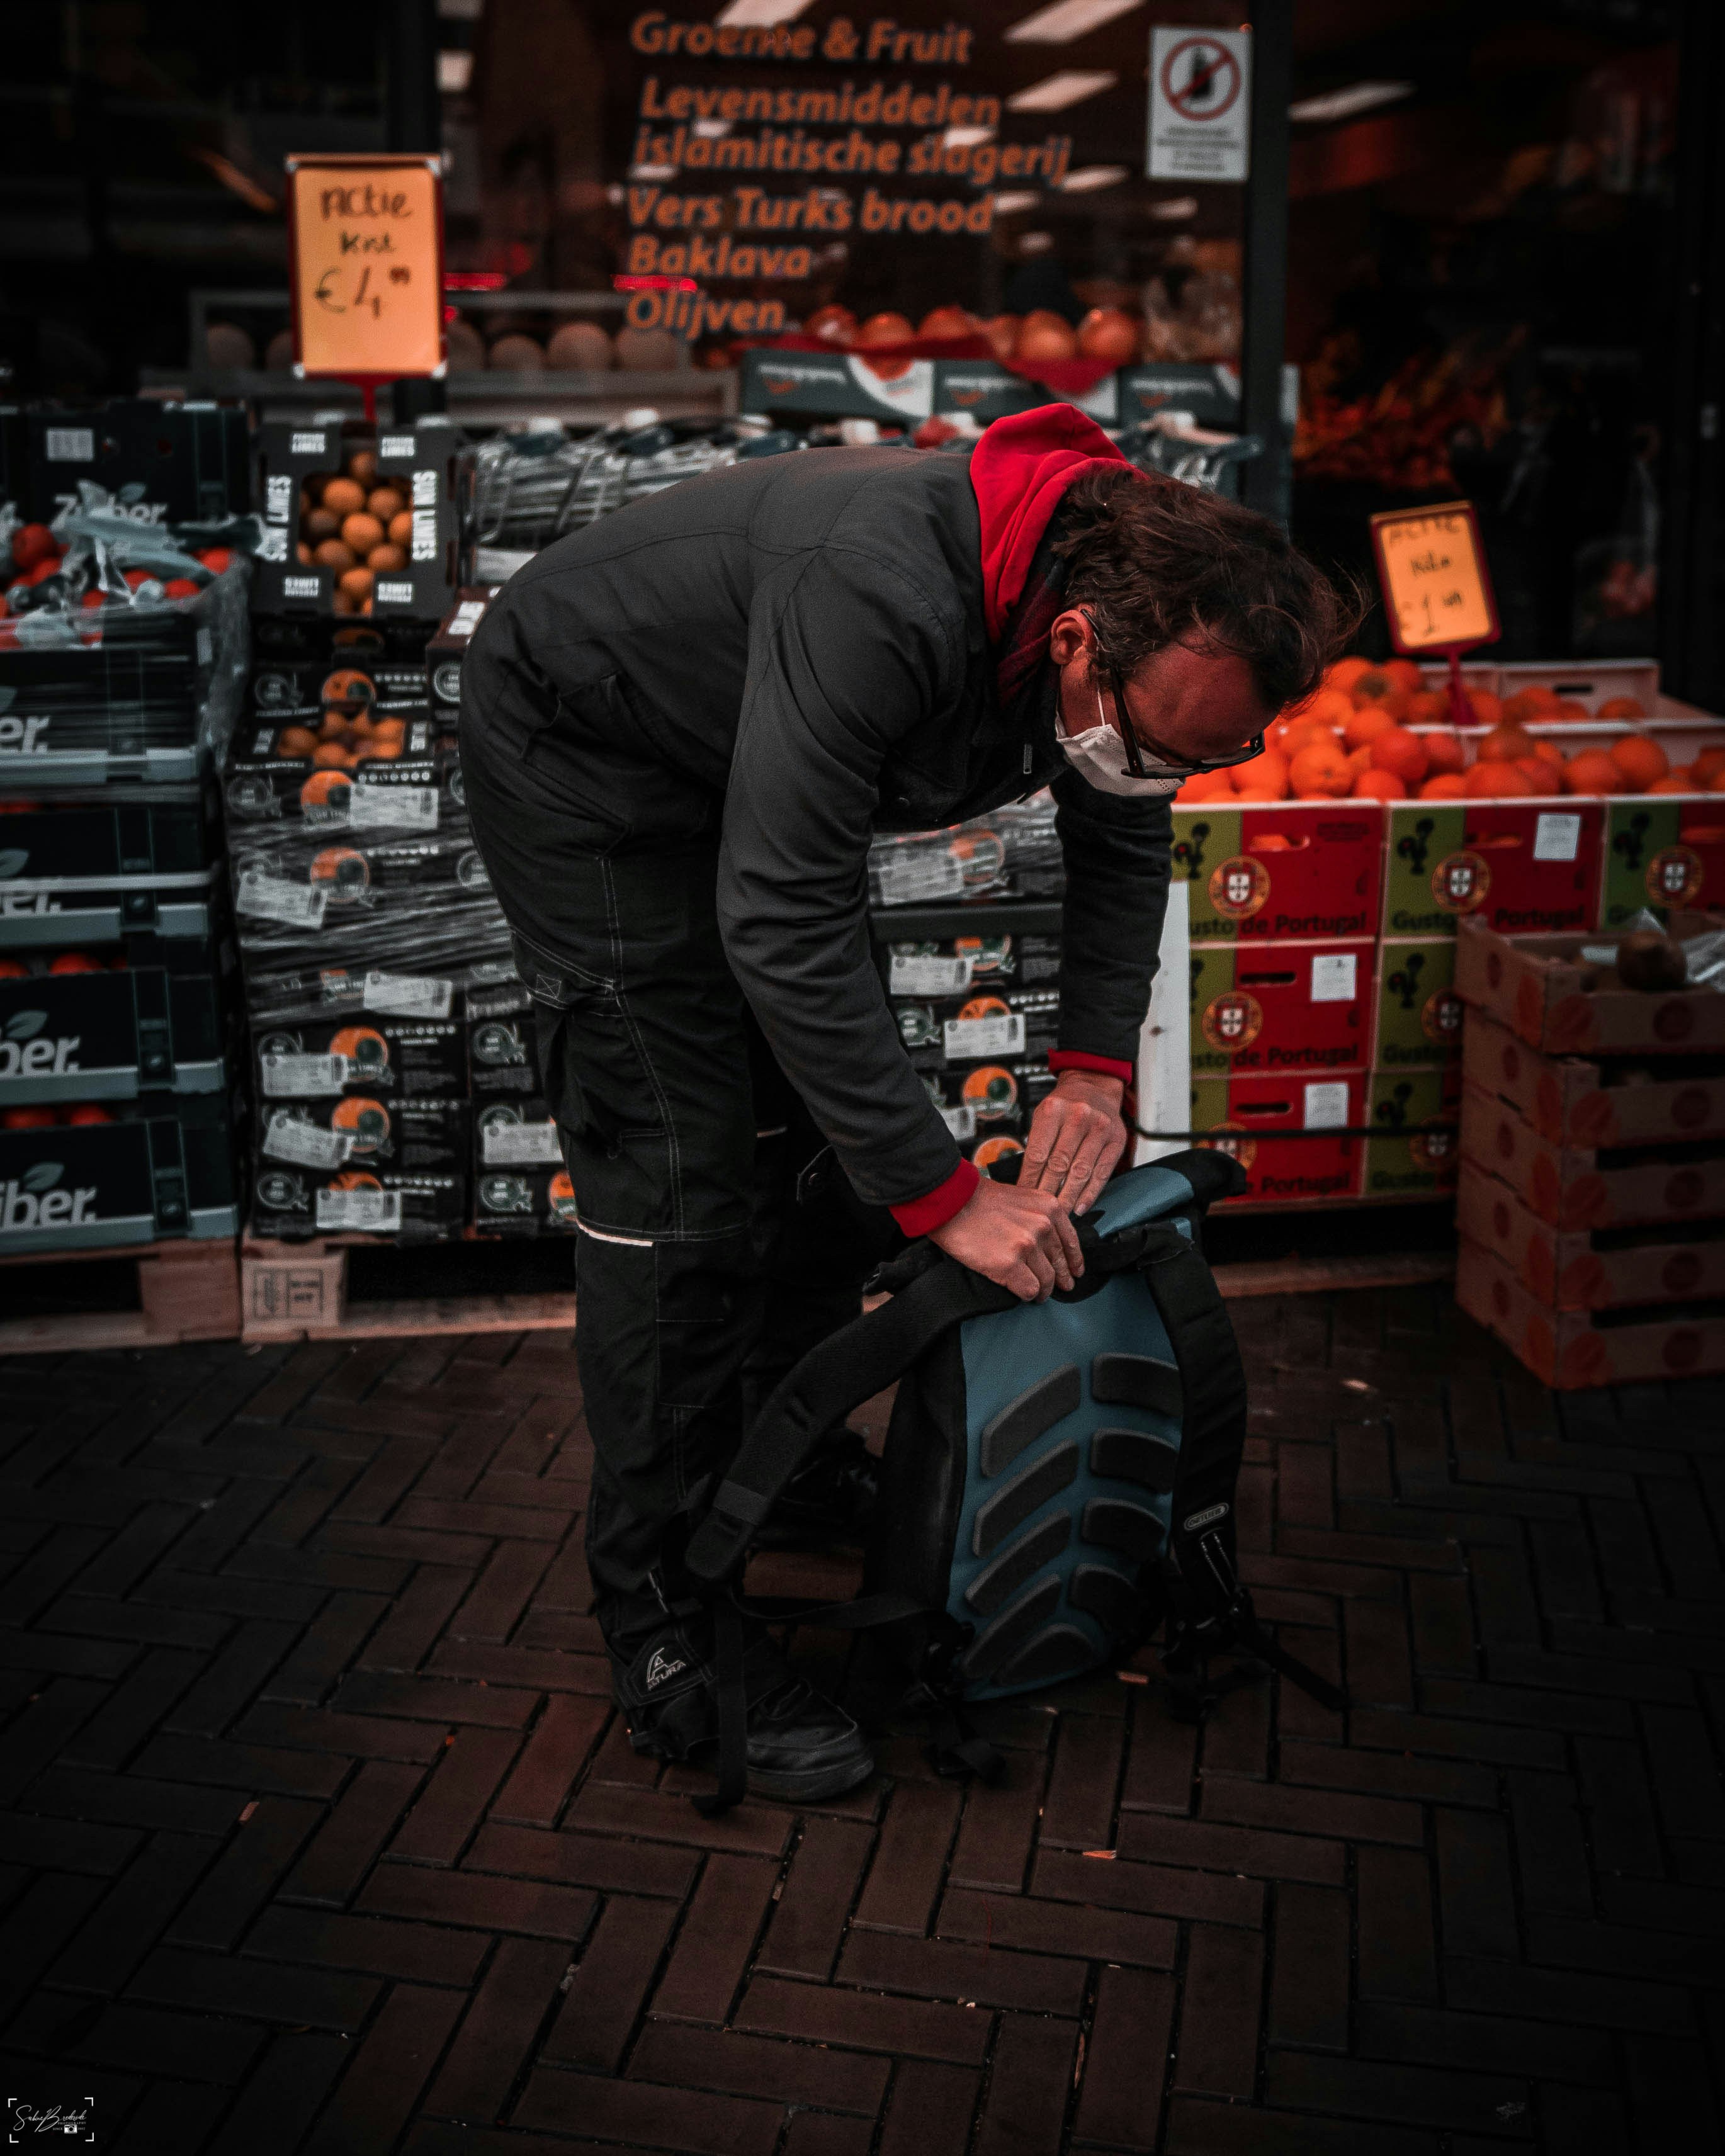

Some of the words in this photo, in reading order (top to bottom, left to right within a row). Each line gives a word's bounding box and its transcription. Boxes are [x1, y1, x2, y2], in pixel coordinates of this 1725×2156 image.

[822, 18, 859, 62] &
[866, 20, 973, 64] Fruit
[639, 77, 1002, 126] Levensmiddelen
[634, 127, 902, 174] islamitische
[907, 136, 1070, 186] slagerij
[629, 188, 722, 227] Vers
[734, 188, 852, 232] Turks
[859, 189, 993, 233] brood
[630, 234, 812, 278] Baklava
[630, 290, 785, 341] Olijven
[1275, 912, 1367, 935] Portugal
